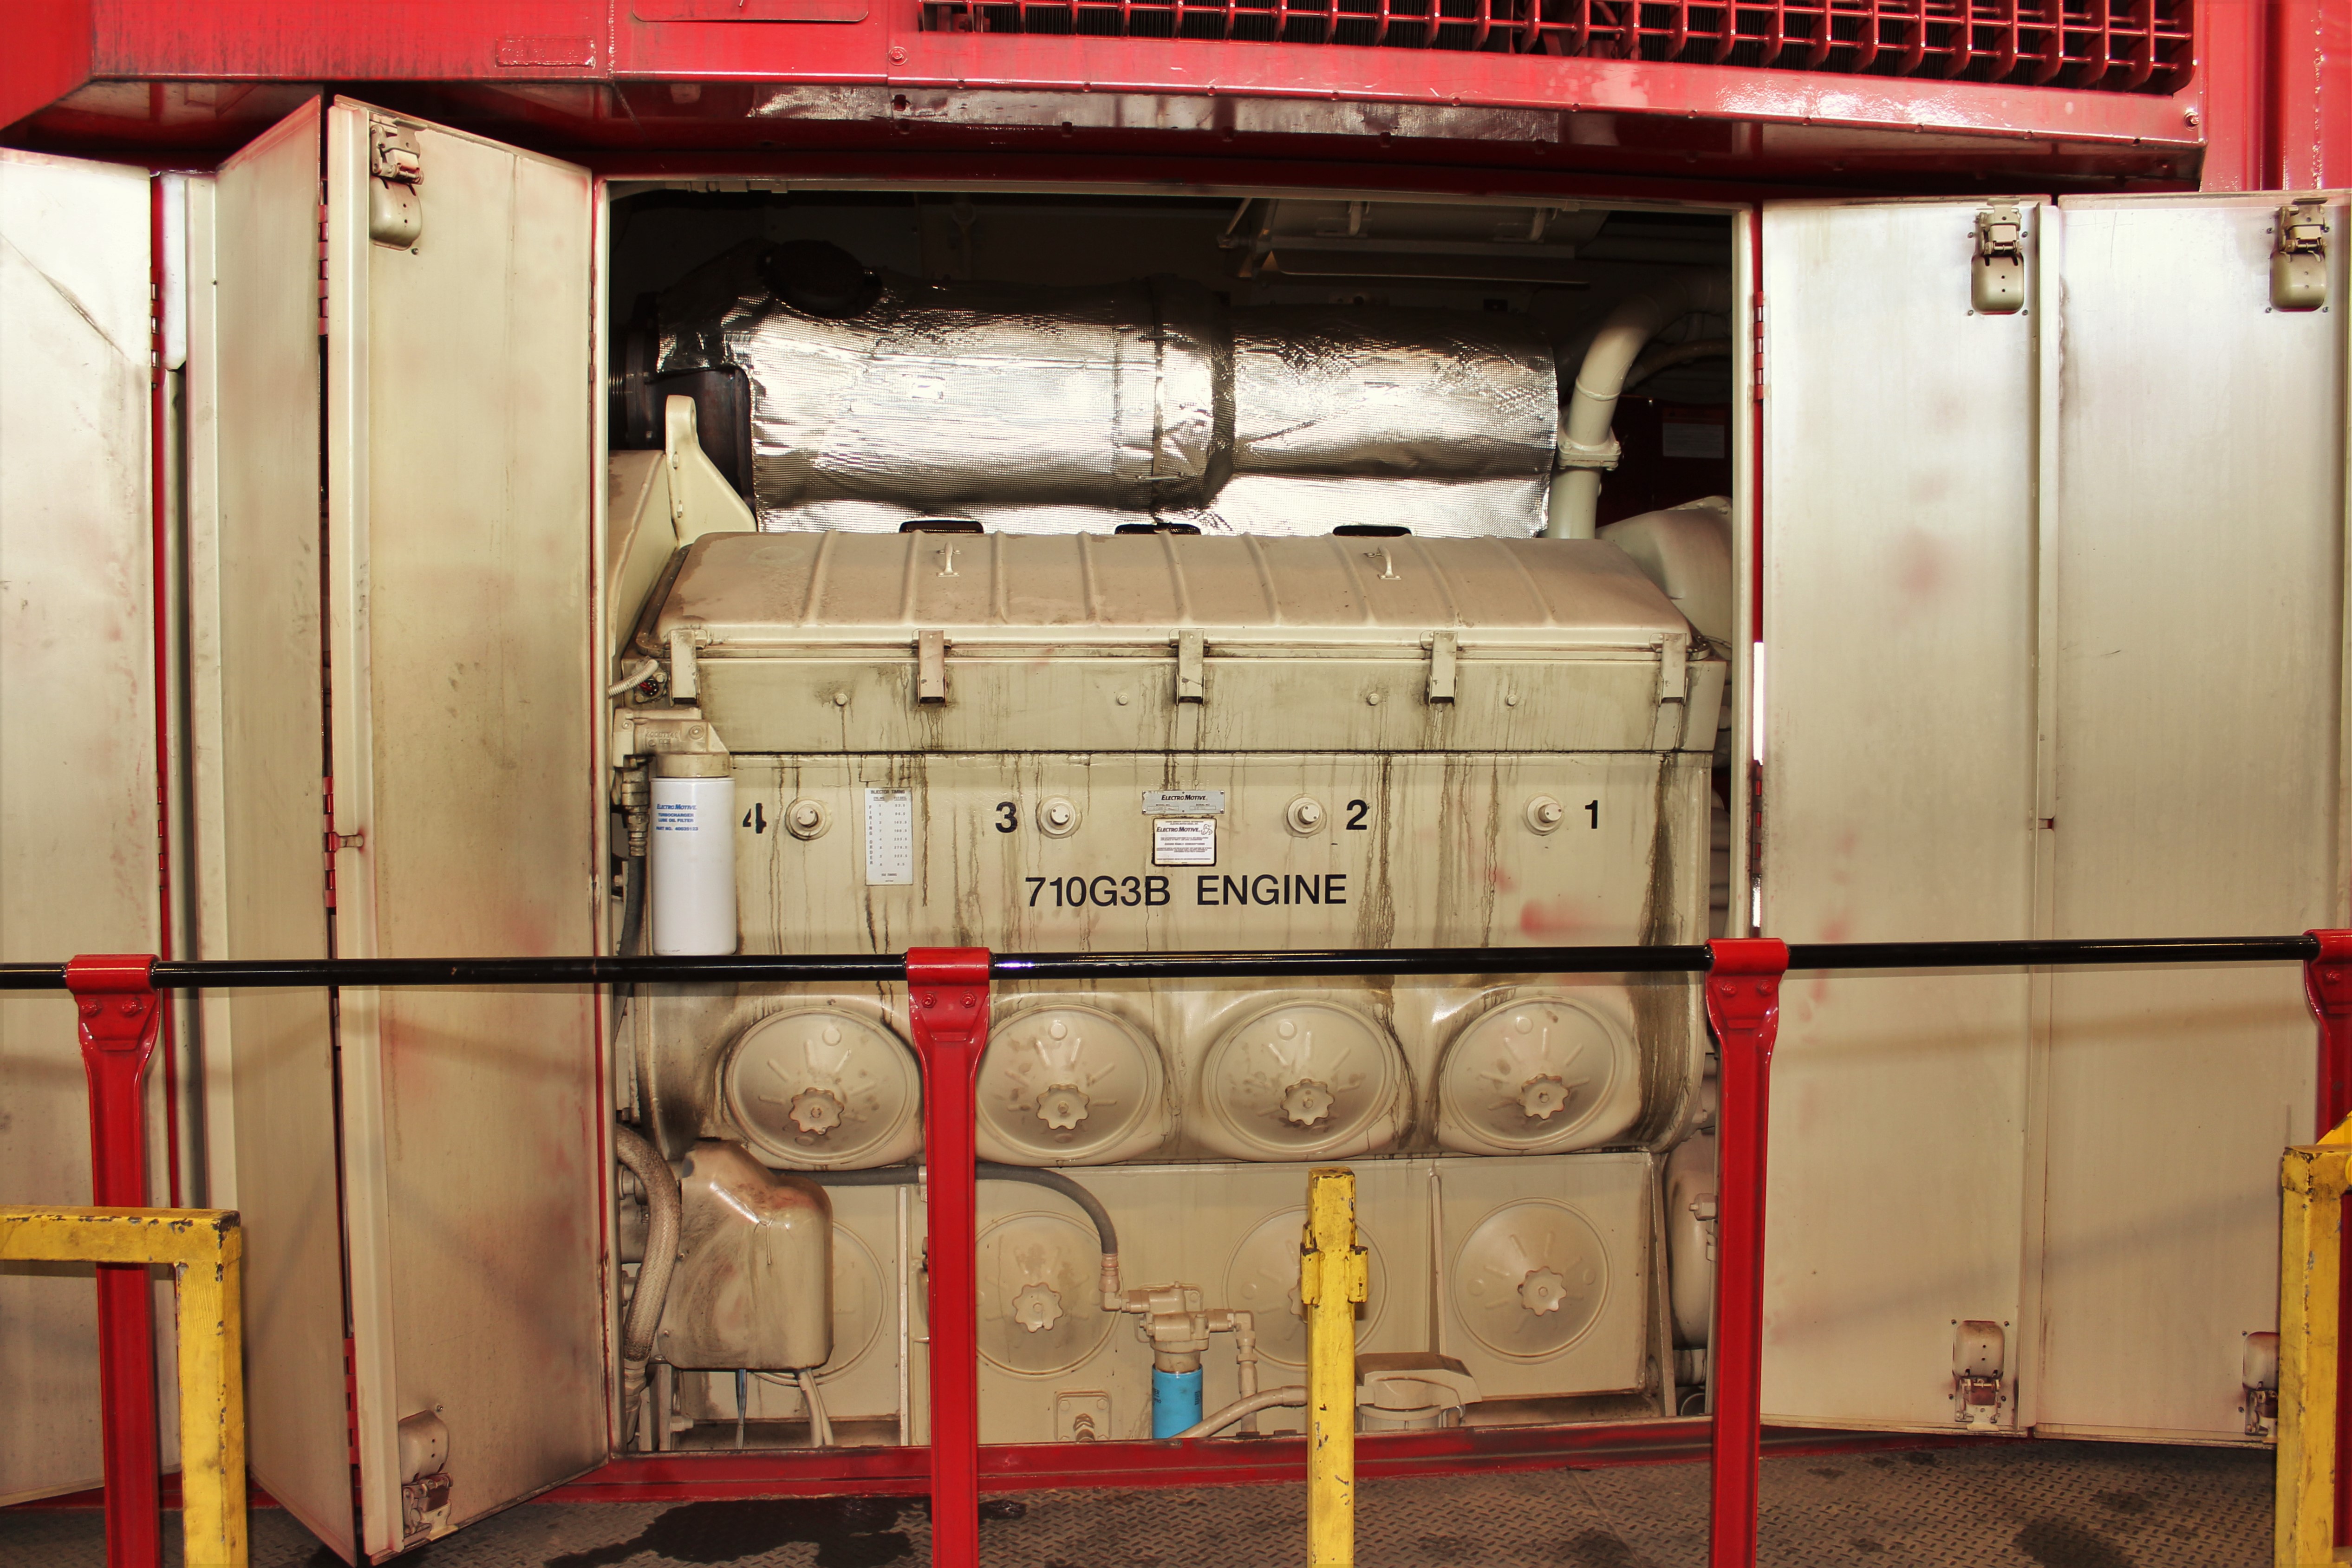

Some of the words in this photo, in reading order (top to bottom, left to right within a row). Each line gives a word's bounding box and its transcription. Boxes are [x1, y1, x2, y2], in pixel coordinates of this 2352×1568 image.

[743, 803, 767, 834] 4
[995, 801, 1018, 833] 3
[1346, 799, 1368, 830] 2
[1585, 800, 1598, 829] 1
[1025, 875, 1171, 907] 710G3B
[1197, 874, 1347, 905] ENGINE
